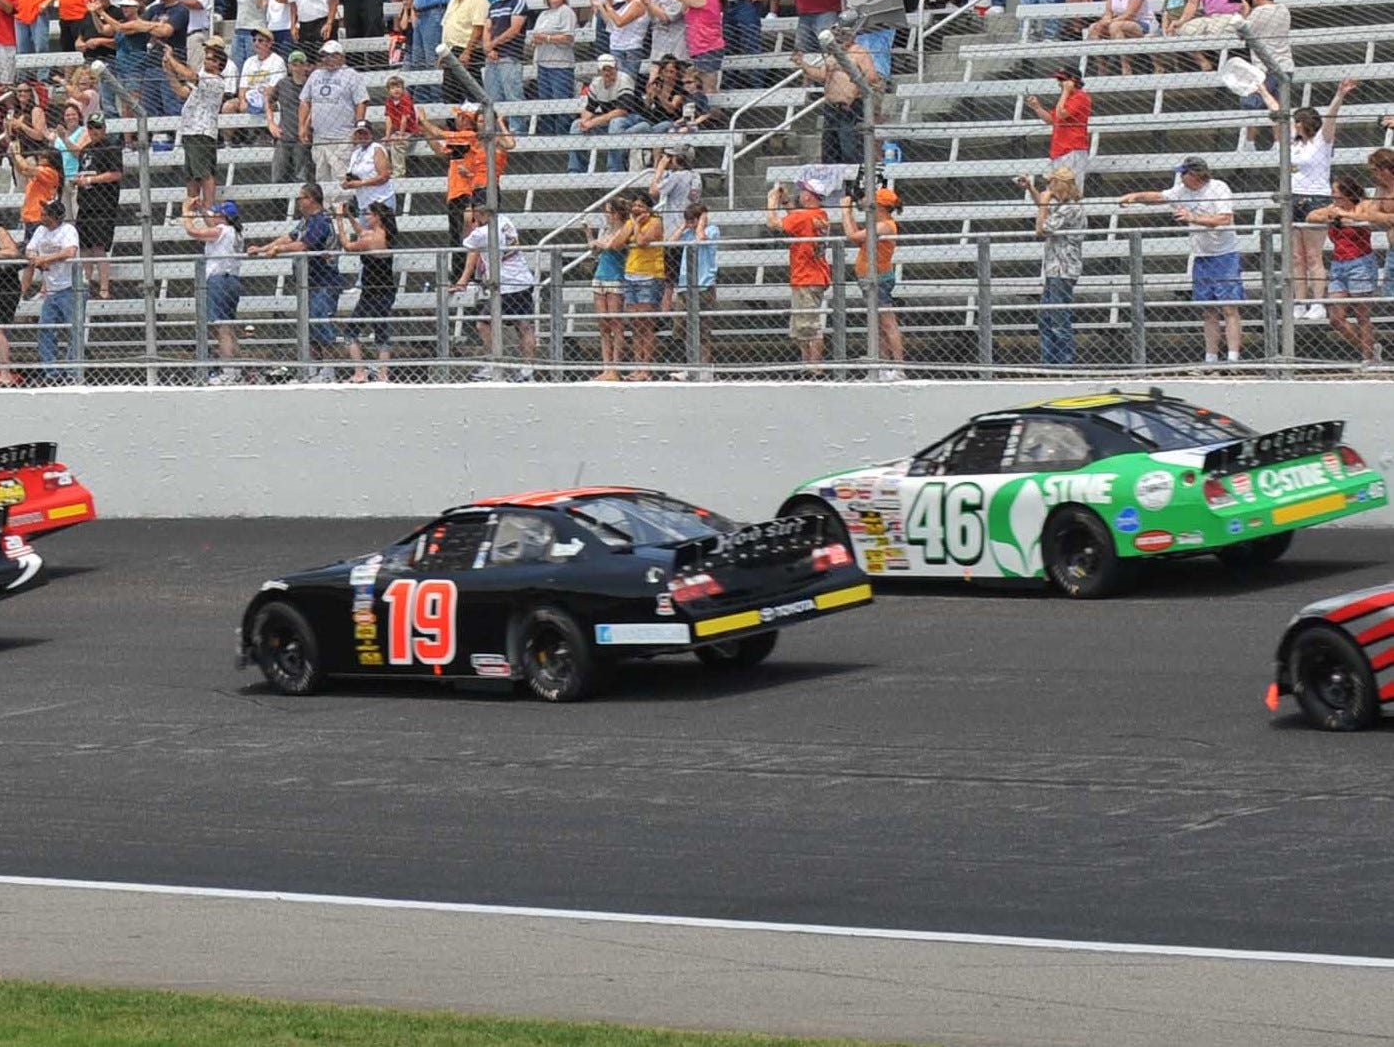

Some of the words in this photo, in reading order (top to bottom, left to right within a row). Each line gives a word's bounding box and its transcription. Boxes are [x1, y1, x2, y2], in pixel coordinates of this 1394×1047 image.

[1043, 473, 1119, 505] STINE
[1279, 462, 1331, 491] STINE
[906, 481, 985, 566] 46
[381, 578, 458, 665] 19
